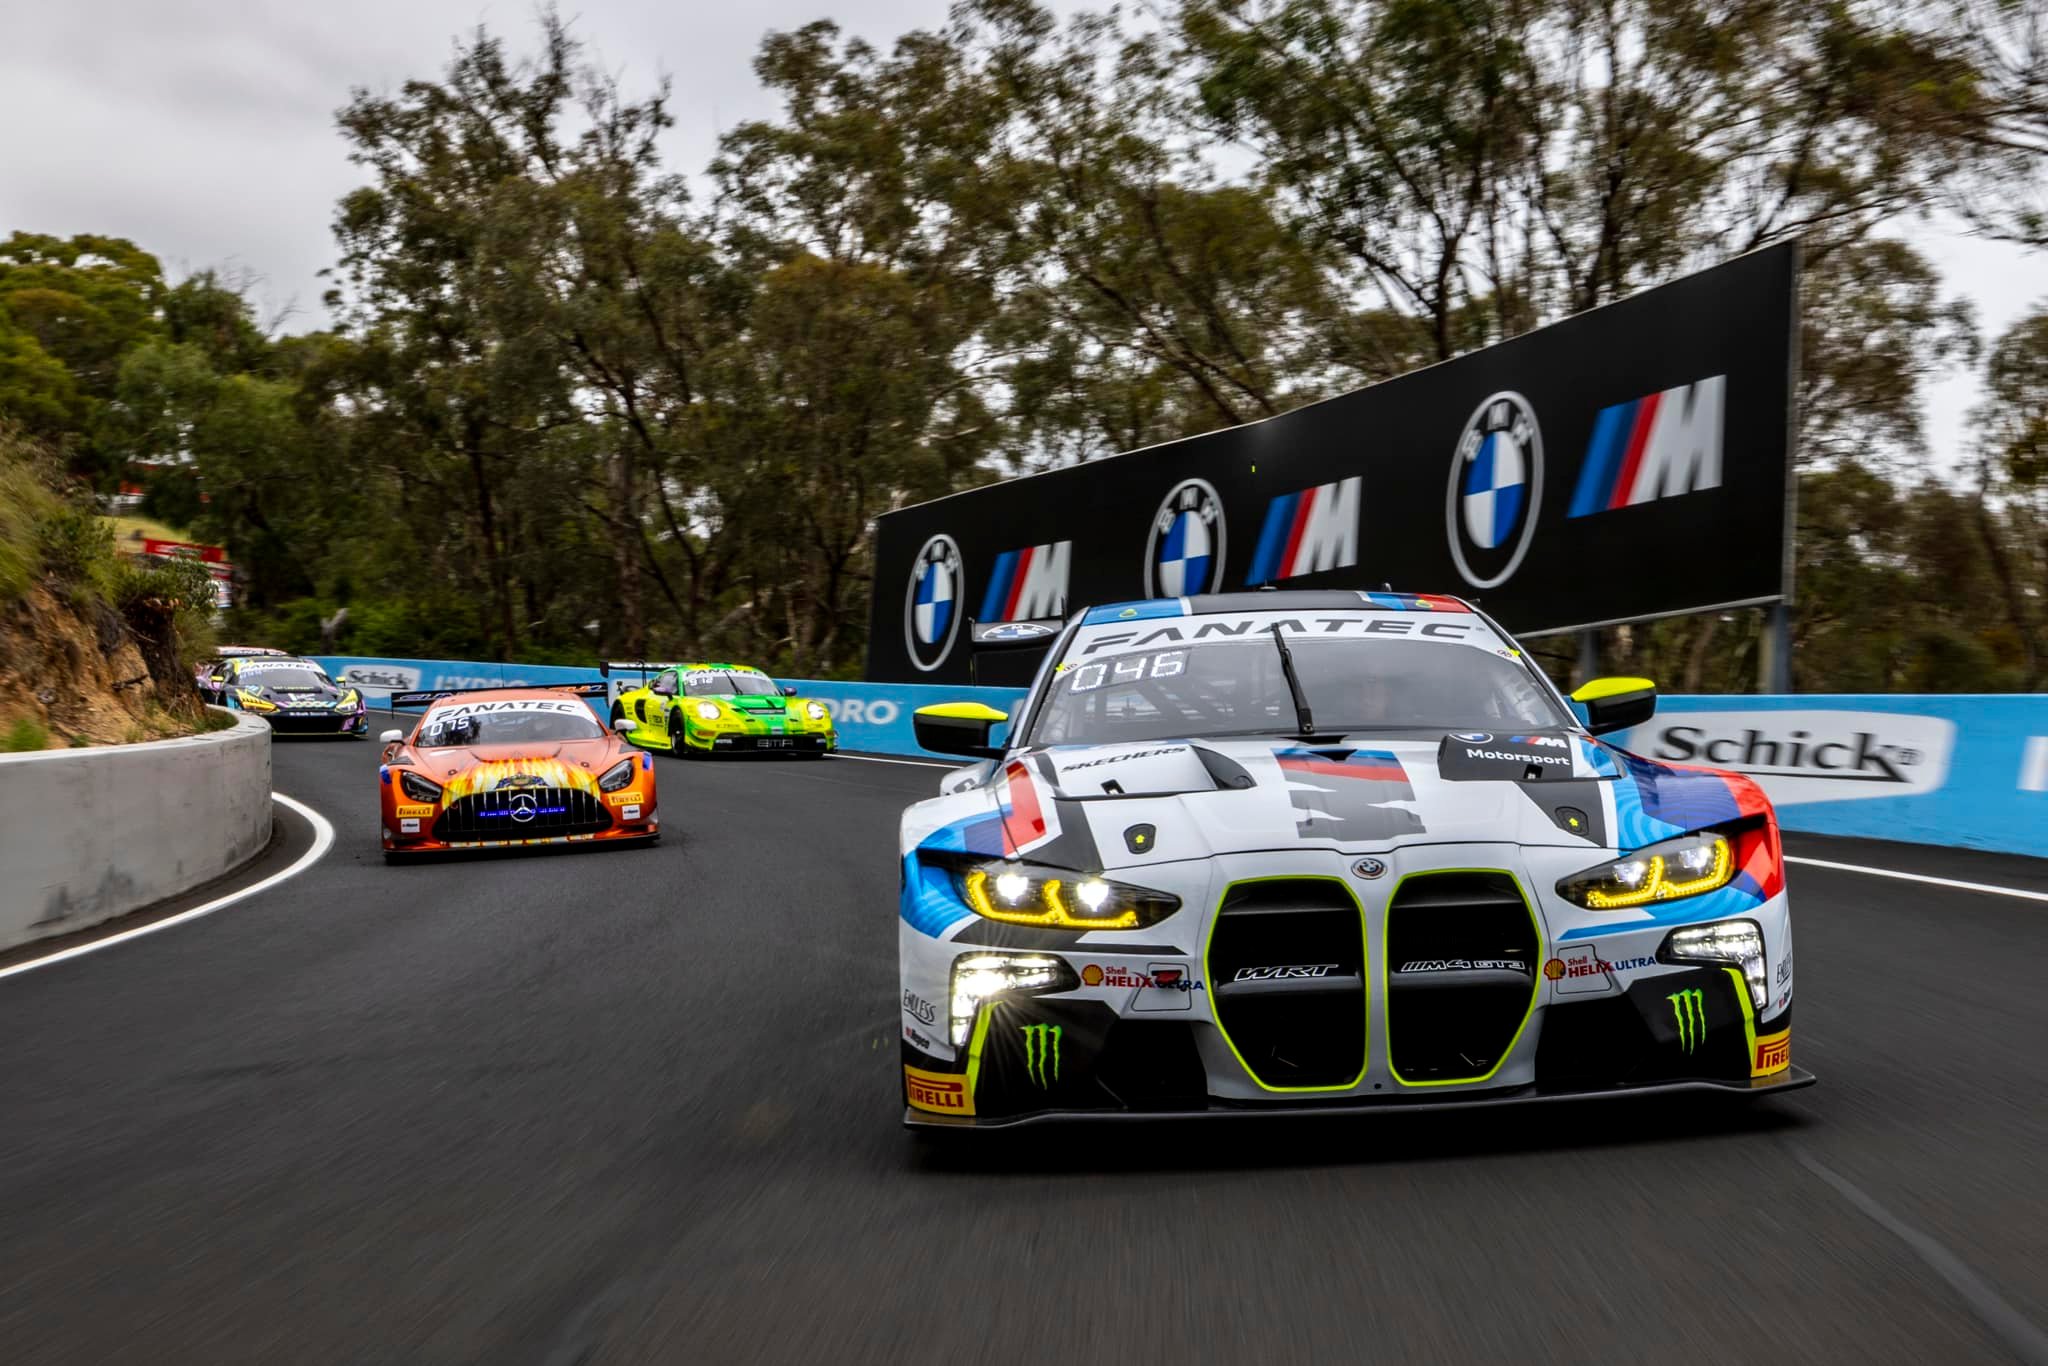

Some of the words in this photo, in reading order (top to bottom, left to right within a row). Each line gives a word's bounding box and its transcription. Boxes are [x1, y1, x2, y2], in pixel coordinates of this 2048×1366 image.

[1624, 374, 1727, 508] M
[1082, 619, 1471, 656] FANATEC
[1070, 650, 1186, 692] 046
[434, 675, 530, 690] HYDR
[435, 702, 575, 721] FANATEC
[429, 716, 470, 736] 075
[1060, 747, 1186, 773] SKECHERS
[1466, 748, 1571, 766] Motorsport
[1653, 725, 1915, 784] Schick
[1105, 966, 1127, 975] Shell
[1567, 956, 1588, 967] Shell
[1568, 961, 1616, 978] HELIX
[1615, 956, 1656, 970] ULTRA
[1105, 973, 1156, 988] HELIX
[1234, 964, 1339, 981] WRT
[907, 1074, 965, 1108] PIRELLI
